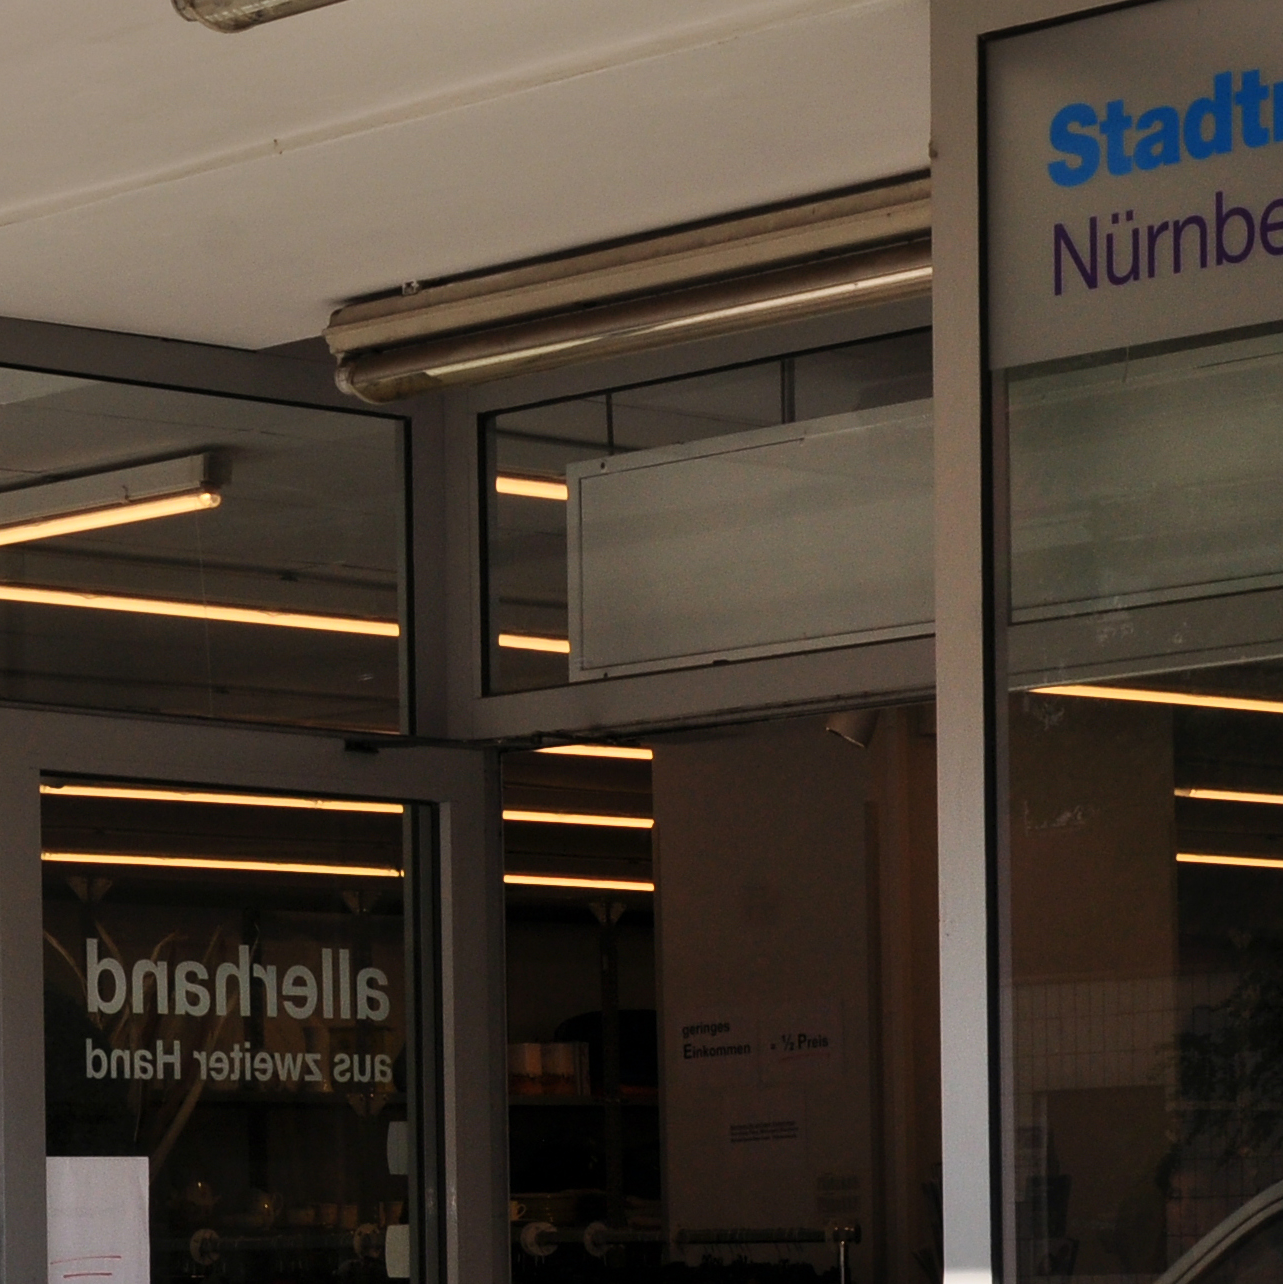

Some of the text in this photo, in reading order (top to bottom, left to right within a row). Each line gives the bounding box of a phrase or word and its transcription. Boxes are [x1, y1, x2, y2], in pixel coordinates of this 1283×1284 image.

[682, 1021, 731, 1038] geringes
[683, 1041, 751, 1060] Einkommen
[797, 1033, 829, 1050] Preis
